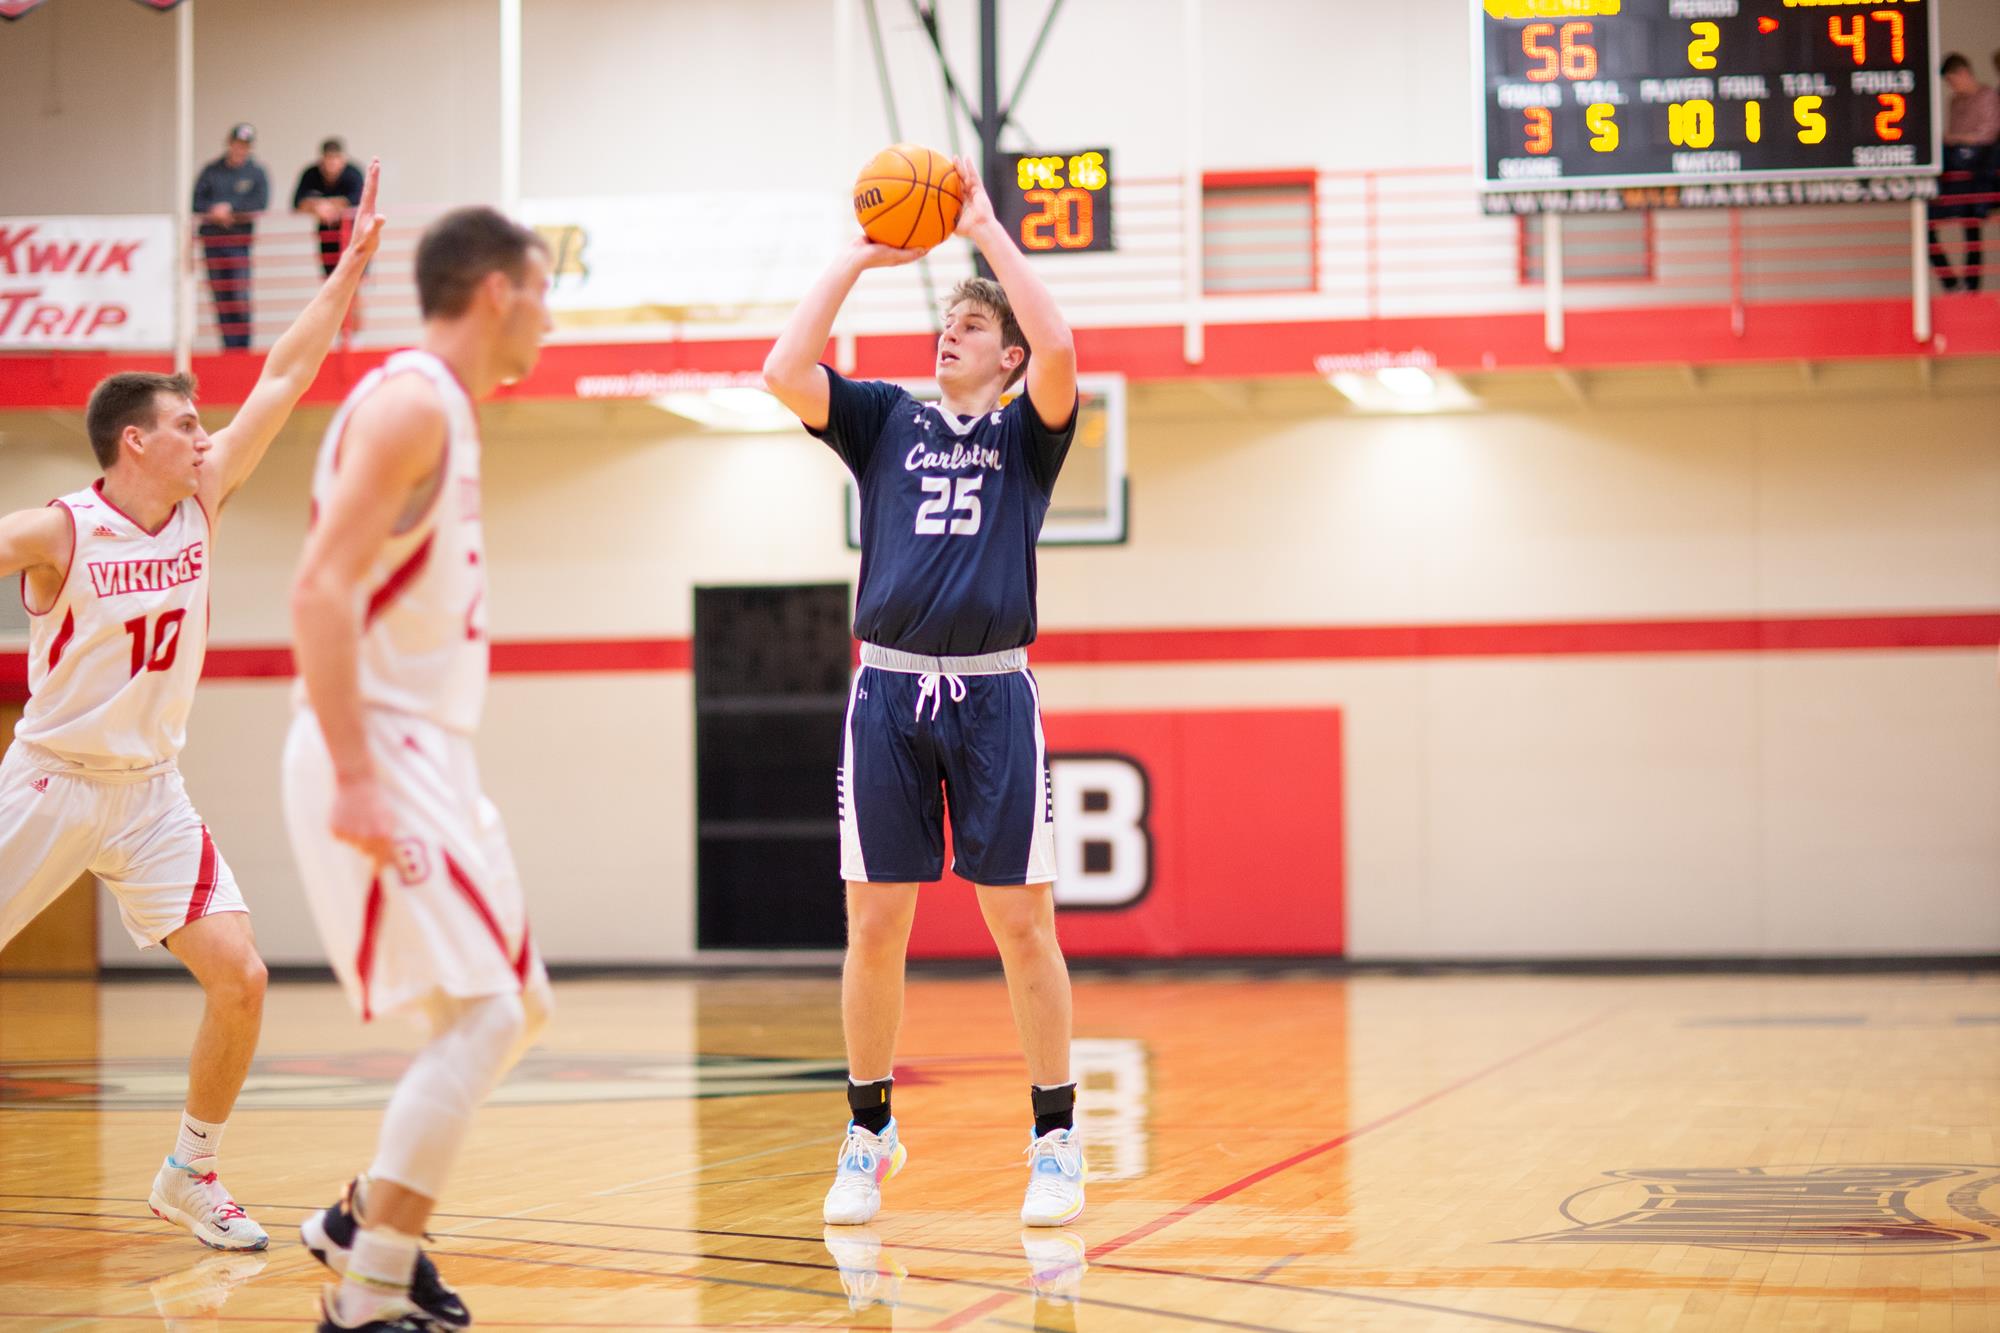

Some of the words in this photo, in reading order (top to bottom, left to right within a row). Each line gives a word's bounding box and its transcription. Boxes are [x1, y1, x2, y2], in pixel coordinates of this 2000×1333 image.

[1522, 22, 1597, 81] 56
[1688, 22, 1719, 69] 2
[1829, 10, 1904, 64] 47
[1852, 70, 1914, 94] FOULS
[1524, 106, 1552, 154] 3
[1586, 103, 1619, 152] 5
[1669, 100, 1714, 148] 10
[1745, 101, 1760, 143] 1
[1794, 95, 1826, 144] 5
[1874, 93, 1906, 140] 2
[1021, 189, 1093, 250] 20
[905, 442, 1002, 471] Carleton
[915, 474, 983, 536] 25
[87, 541, 203, 598] VIKINGS
[124, 607, 187, 679] 10
[1052, 751, 1152, 912] B
